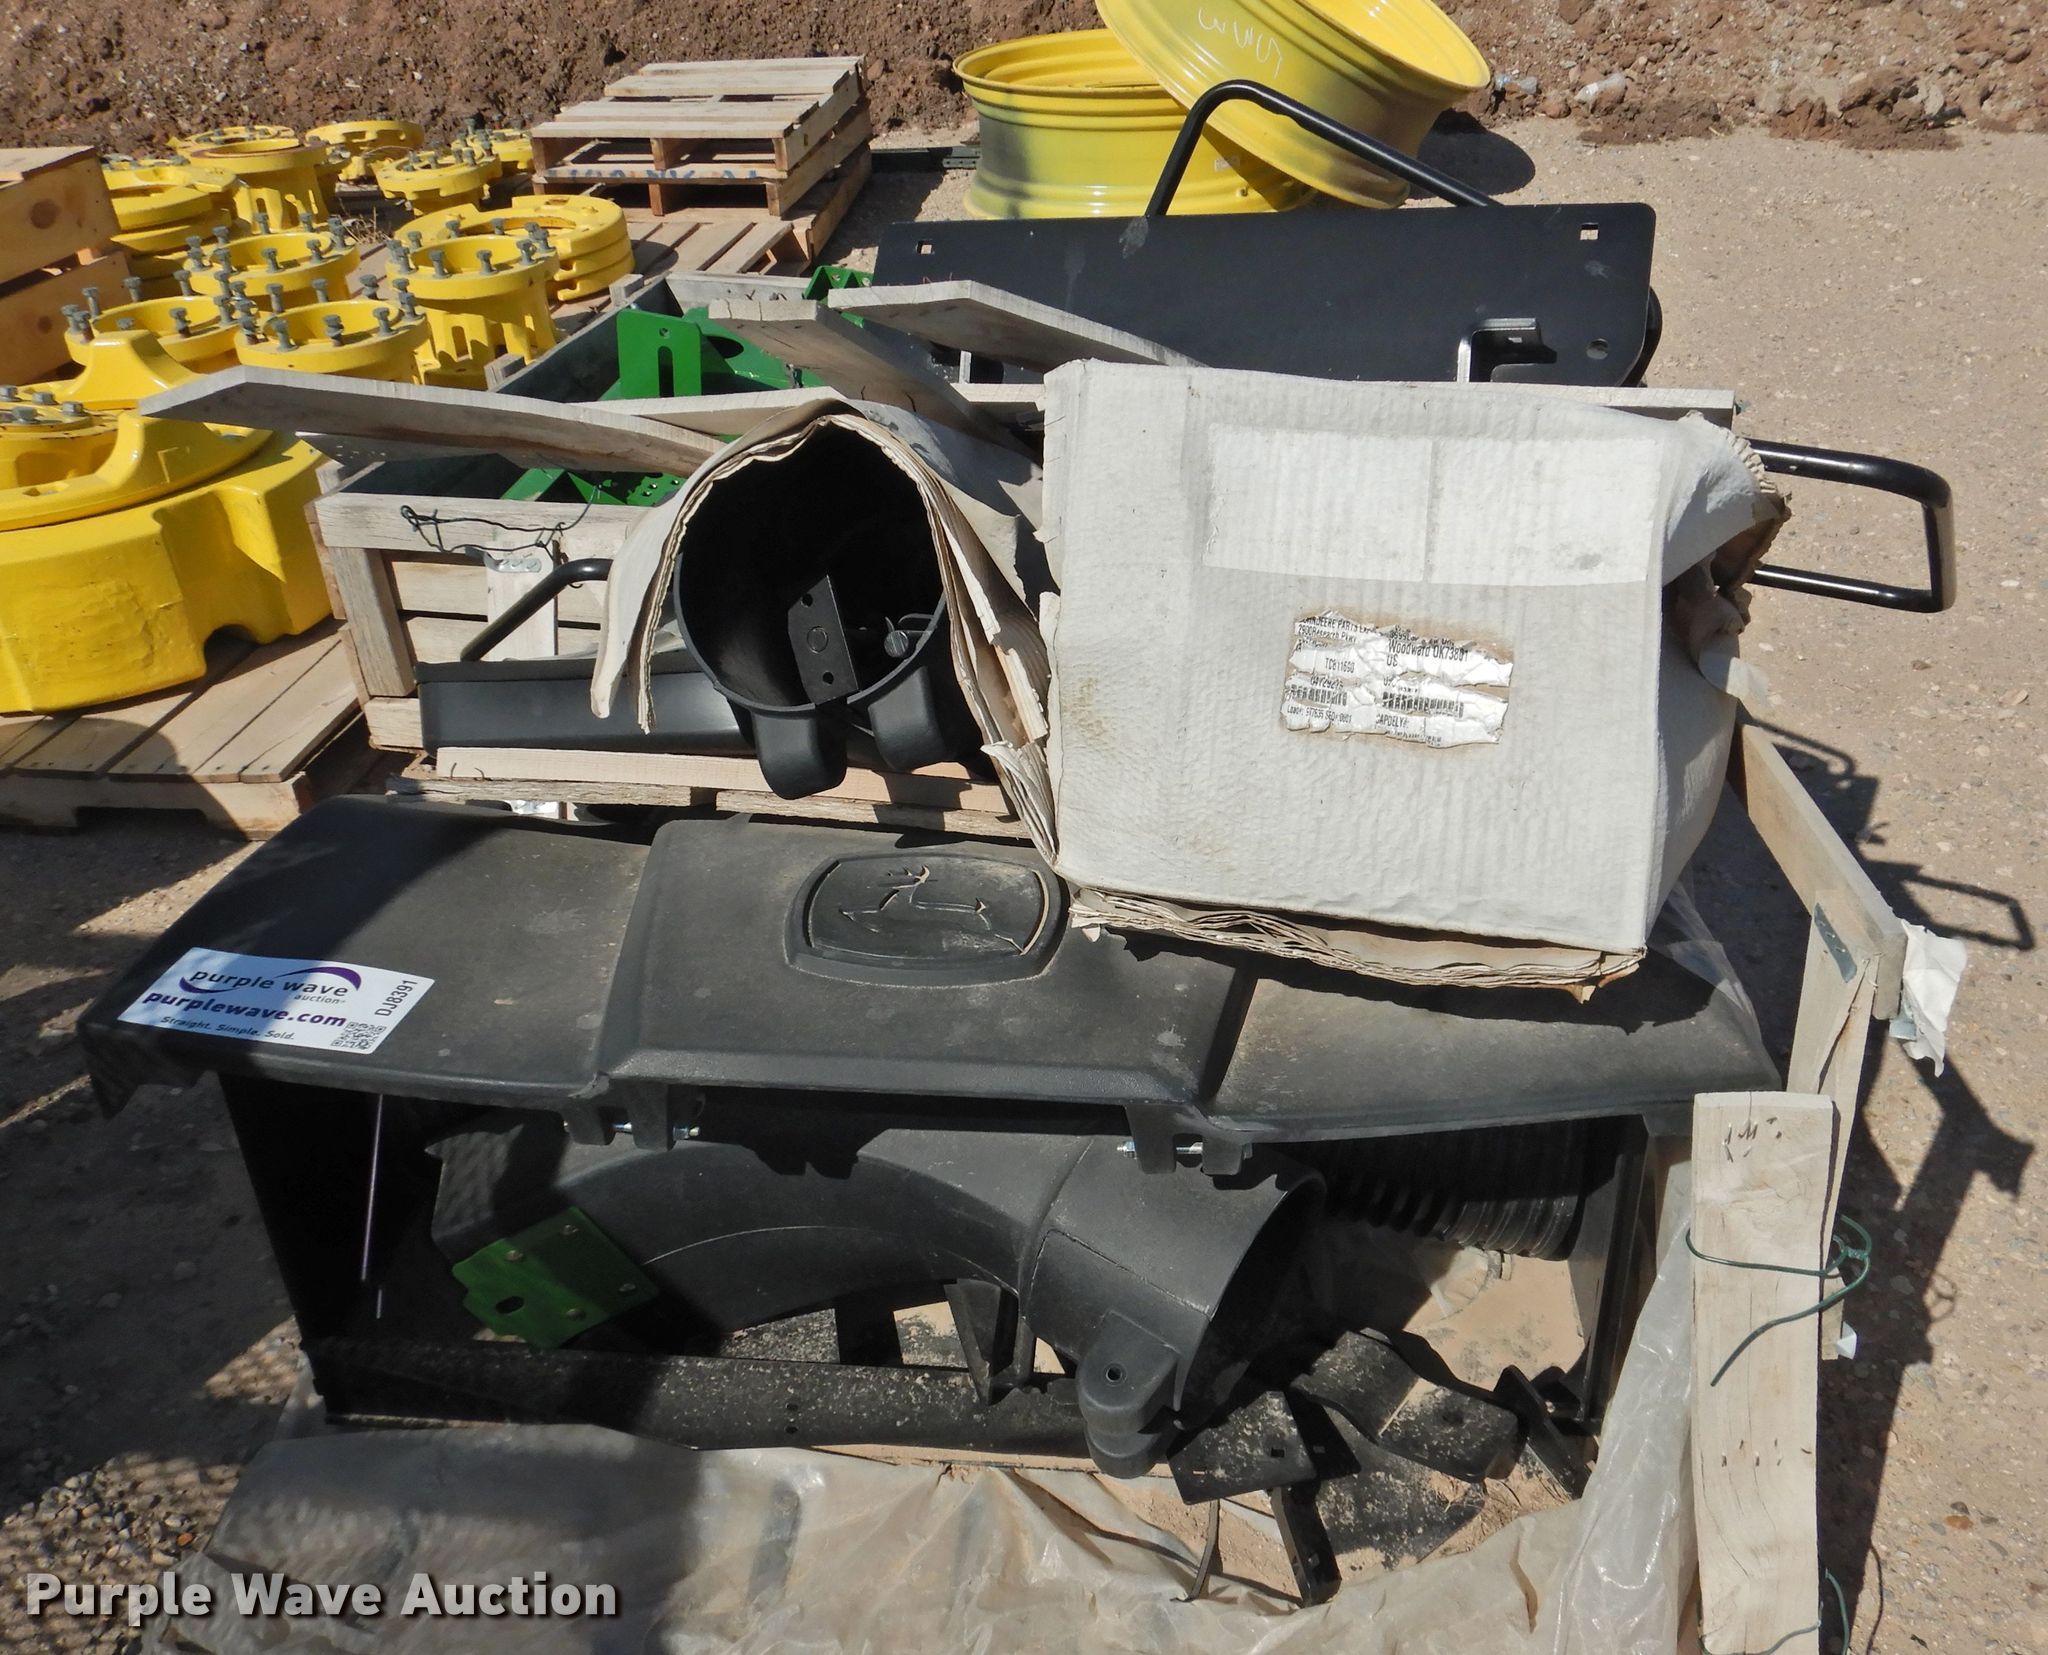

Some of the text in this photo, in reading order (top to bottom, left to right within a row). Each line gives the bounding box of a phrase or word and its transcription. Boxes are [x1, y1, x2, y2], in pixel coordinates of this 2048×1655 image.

[1388, 639, 1431, 657] Woodward
[189, 970, 348, 997] purple wave
[142, 991, 347, 1027] purplewave.com
[294, 993, 341, 1005] auction
[375, 978, 418, 1017] DJ8391
[160, 1015, 295, 1041] Straight. Simple. Sold.
